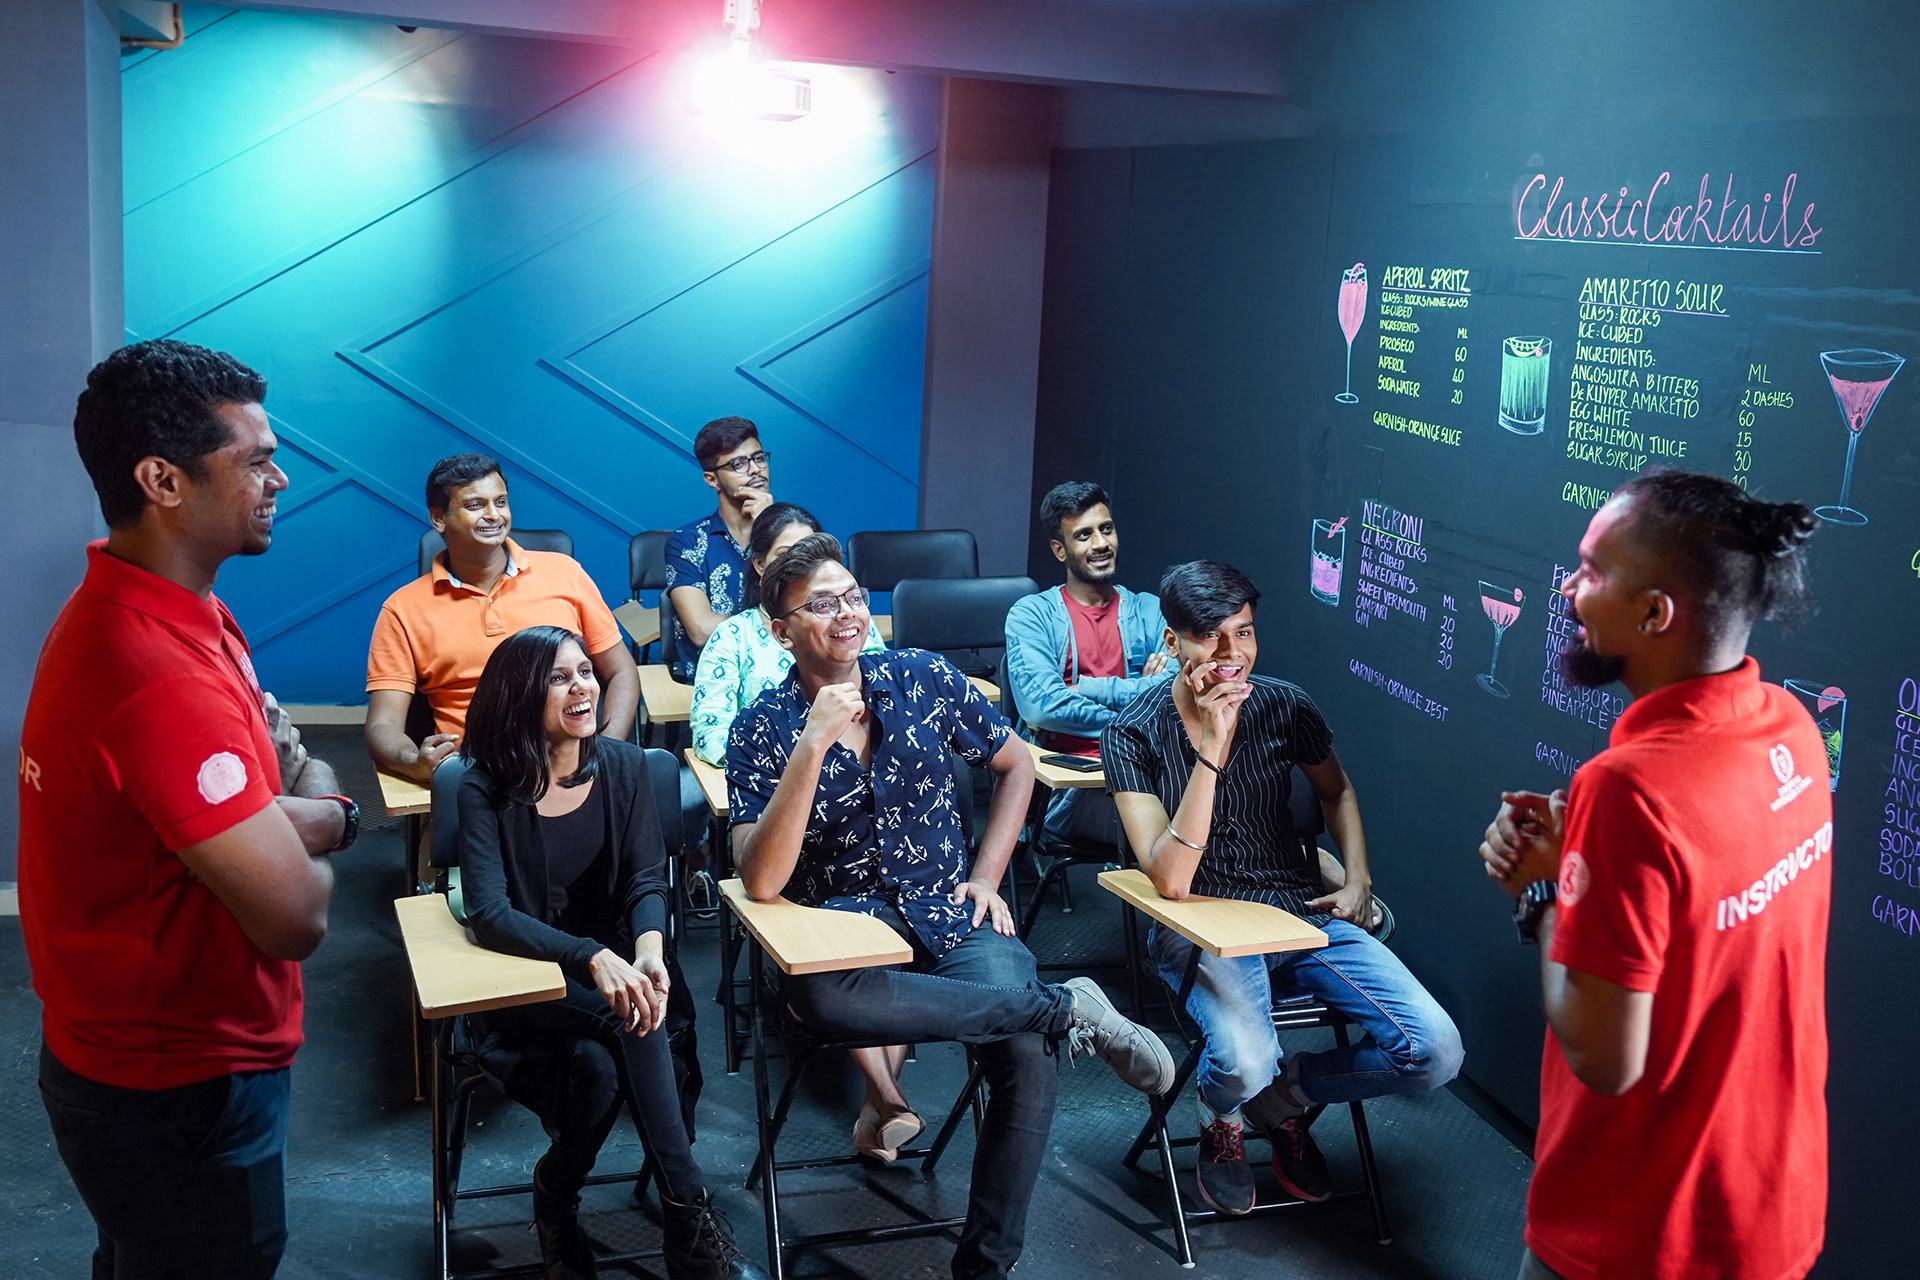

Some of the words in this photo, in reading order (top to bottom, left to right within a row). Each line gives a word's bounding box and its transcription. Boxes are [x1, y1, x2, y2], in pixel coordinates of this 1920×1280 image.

[1382, 266, 1426, 289] APEROL
[1429, 268, 1471, 293] SPRITZ
[1579, 277, 1670, 307] AMARETTO
[1676, 280, 1727, 313] SOUR
[1457, 327, 1468, 339] ML
[1380, 335, 1415, 353] PROSECO
[1454, 346, 1468, 362] 60
[1575, 339, 1657, 368] INGREDIENTS:
[1378, 355, 1407, 373] APEROL
[1747, 363, 1771, 384] ML
[1452, 367, 1465, 383] 40
[1570, 363, 1640, 388] ANGOSUTRA
[1645, 373, 1699, 399] BITTERS
[1451, 389, 1463, 405] 20
[1630, 391, 1700, 419] AMARETTO
[1740, 389, 1751, 407] 2
[1753, 390, 1794, 408] DASHES
[1569, 400, 1591, 420] EGG
[1593, 404, 1632, 427] WHITE
[1738, 409, 1755, 427] 60
[1440, 426, 1462, 447] SLICE
[1649, 436, 1687, 457] JUICE
[1736, 431, 1752, 448] 15
[1566, 440, 1604, 465] SUGAR
[1605, 448, 1648, 473] SYRUP
[1733, 450, 1752, 472] 30
[1362, 500, 1424, 544] NEGRONI
[1378, 551, 1405, 571] CUBED
[1360, 559, 1419, 594] INGREDIENTS:
[1355, 595, 1389, 621] CAMPARI
[1357, 578, 1383, 600] SWEET
[1383, 589, 1427, 622] VERMOUTH
[1442, 594, 1458, 612] ML
[1355, 609, 1370, 629] GIN
[1440, 615, 1455, 633] 20
[1438, 632, 1454, 650] 20
[1437, 650, 1453, 670] 20
[1424, 698, 1449, 722] ZEST
[1541, 685, 1608, 731] PINEAPPLE
